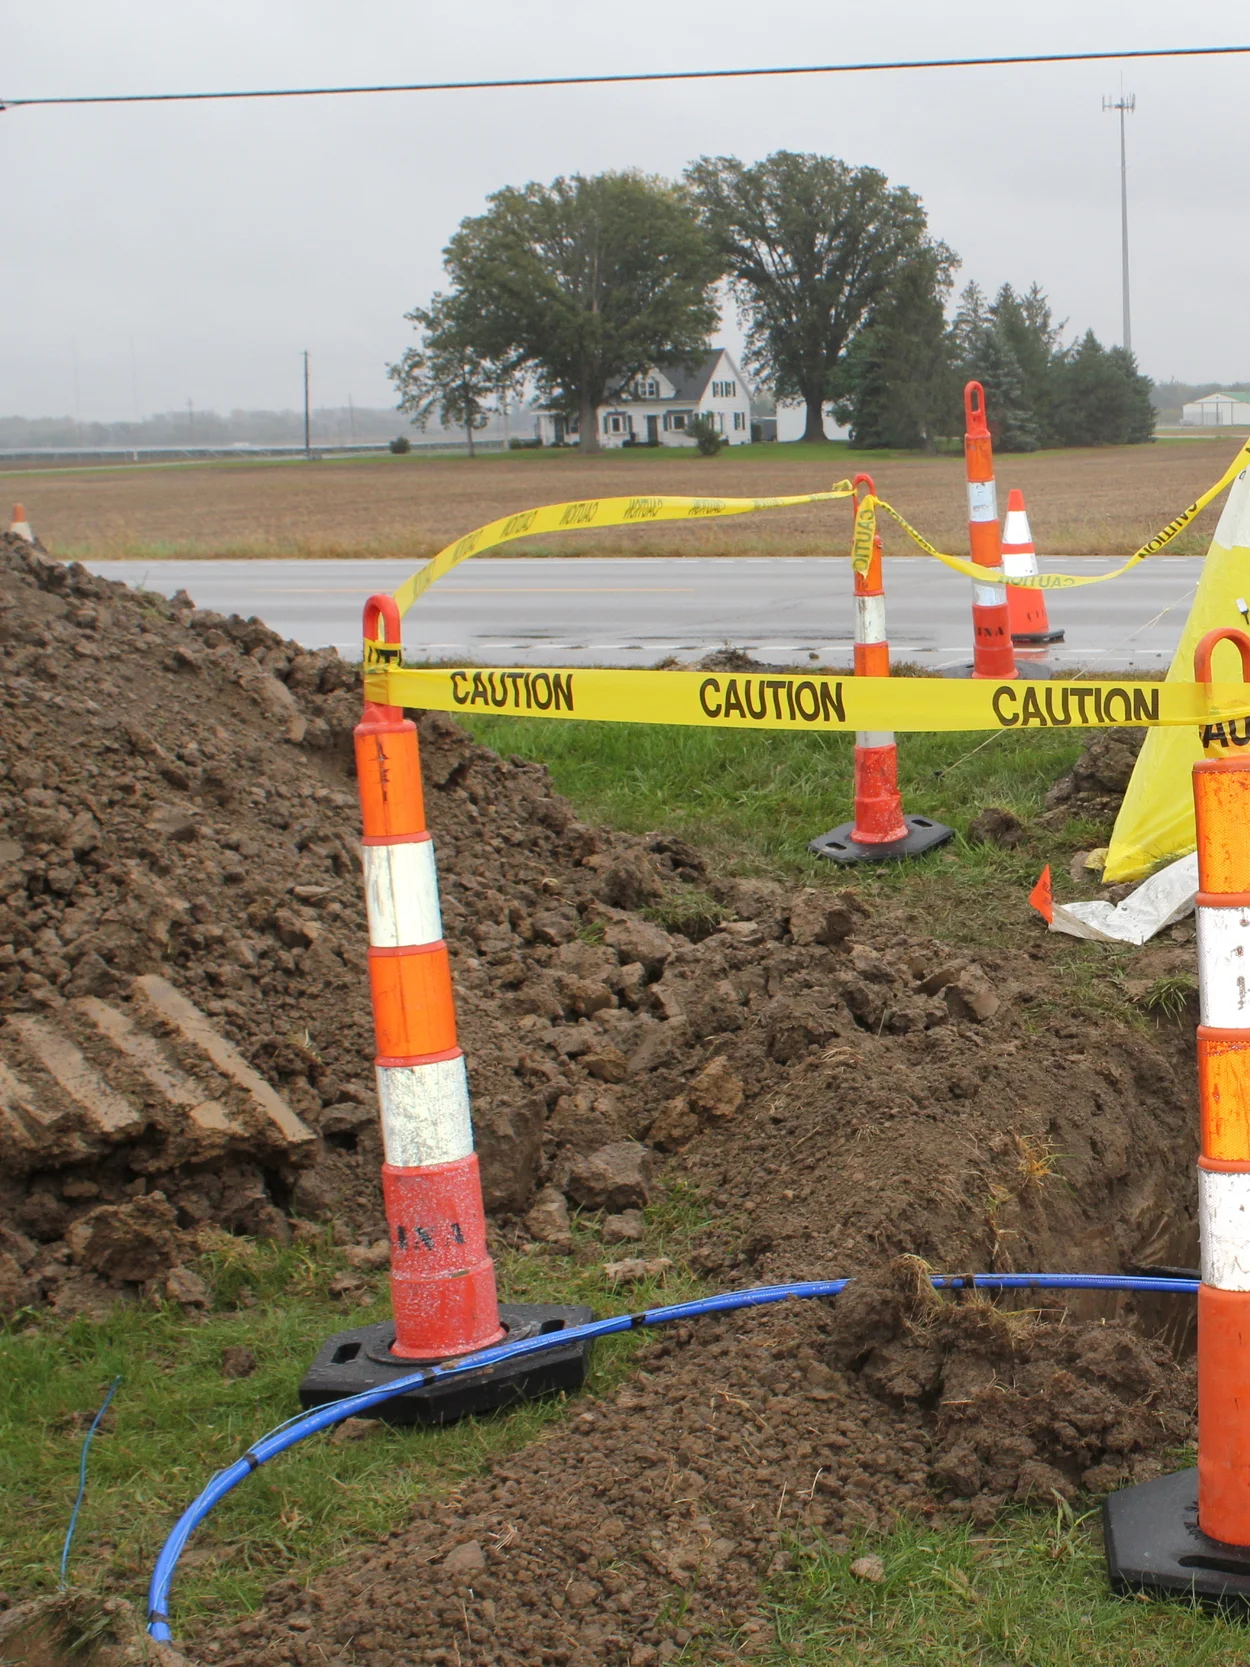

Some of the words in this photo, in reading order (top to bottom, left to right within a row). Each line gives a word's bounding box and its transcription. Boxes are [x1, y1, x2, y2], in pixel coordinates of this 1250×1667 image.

[450, 670, 574, 711] CAUTION
[700, 677, 846, 723] CAUTION
[992, 685, 1160, 727] CAUTION
